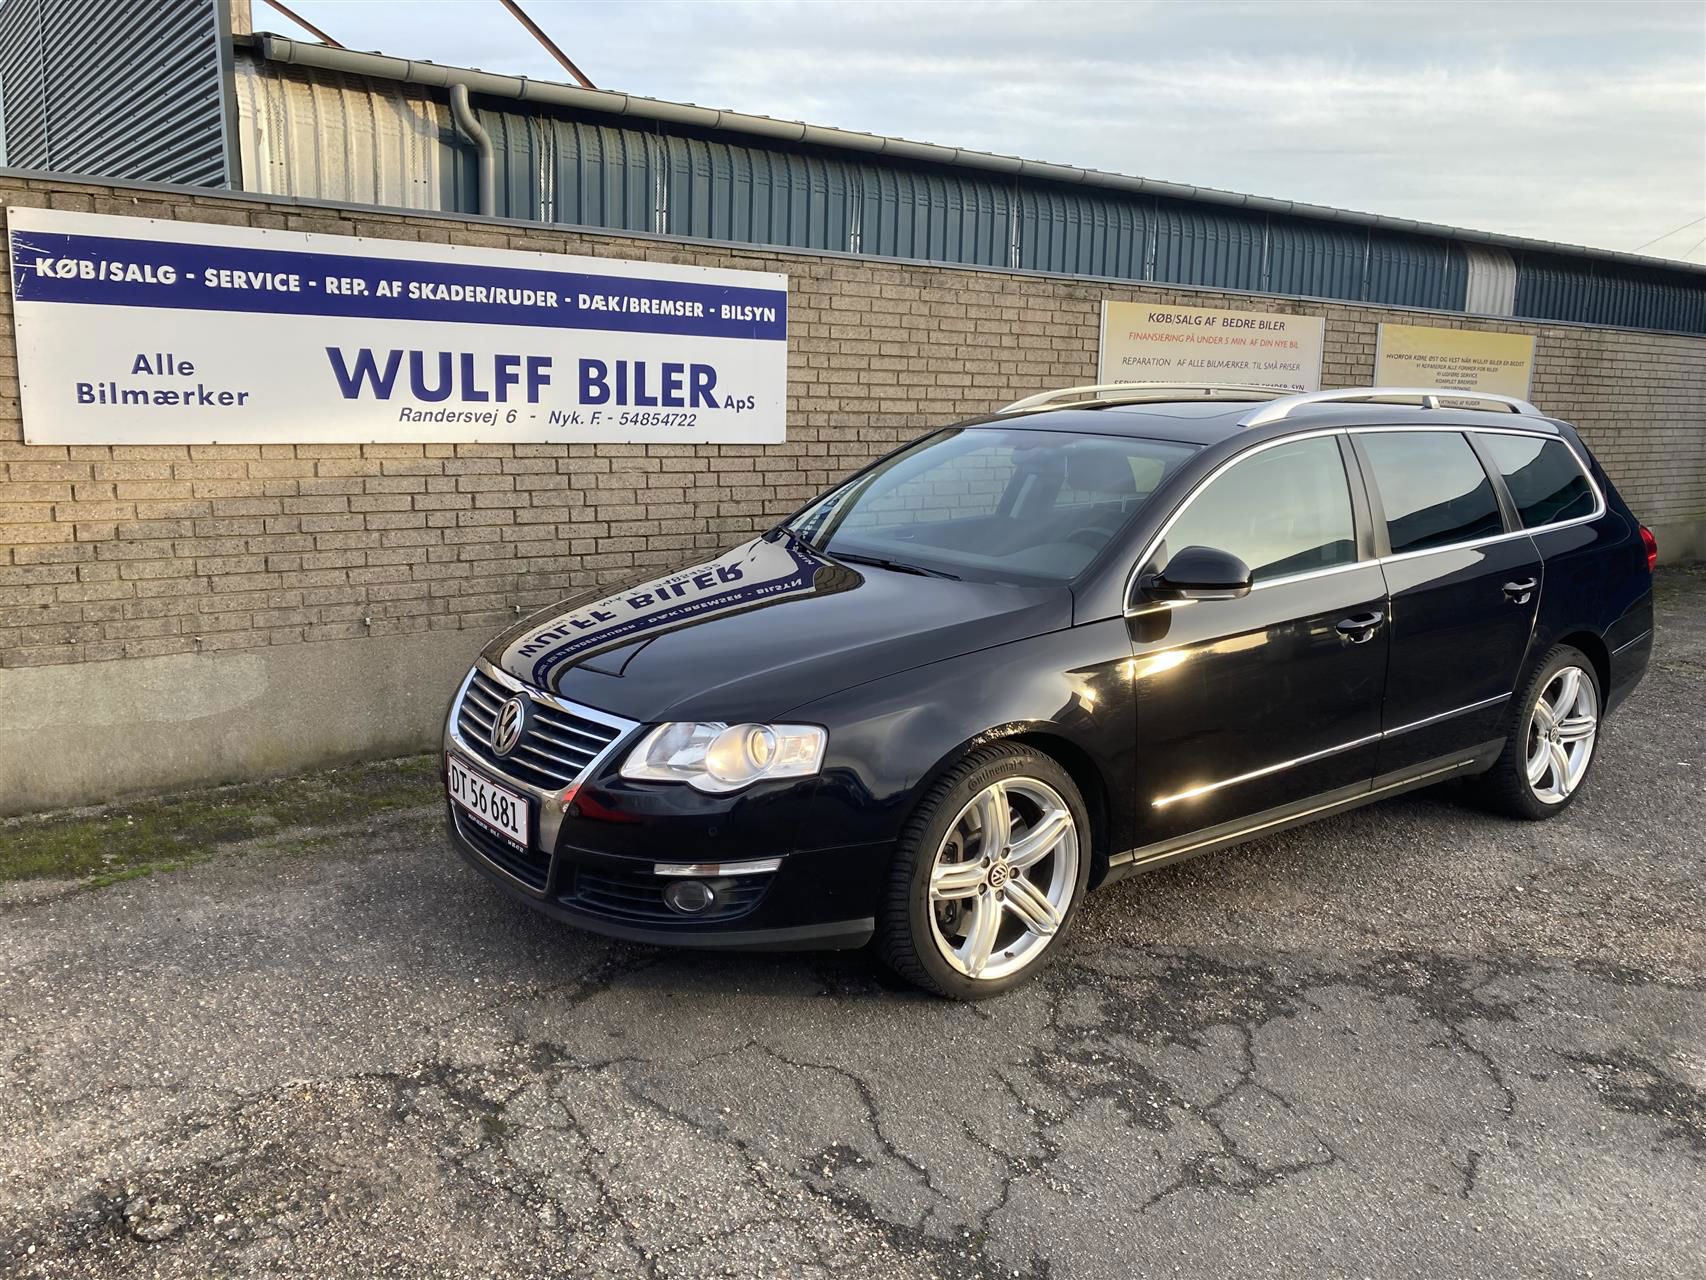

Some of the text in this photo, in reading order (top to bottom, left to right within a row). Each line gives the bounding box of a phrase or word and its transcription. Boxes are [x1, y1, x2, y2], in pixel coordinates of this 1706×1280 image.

[35, 256, 177, 286] KØB/SALG
[204, 267, 301, 292] SERVICE
[325, 276, 369, 296] REP.
[375, 280, 402, 299] AF
[408, 281, 559, 308] SKADER/RUDER
[578, 293, 704, 318] DÆK/BREMSER
[721, 304, 776, 323] BILSYN
[1148, 313, 1286, 331] KØB/SALG AF BEDRE BILER
[1128, 331, 1185, 343] FINANSIERING
[1196, 335, 1224, 345] UNDER
[1249, 338, 1260, 346] AF
[1260, 339, 1273, 348] DIN
[1274, 340, 1288, 349] NYE
[131, 353, 196, 377] Alle
[1122, 356, 1171, 367] REPARATION
[1176, 358, 1187, 367] AF
[1188, 359, 1205, 368] ALLE
[1206, 360, 1249, 369] BILMÆRKER
[1253, 361, 1262, 370] TIL
[1279, 362, 1301, 371] PRISER
[325, 346, 755, 414] WULFF BILER ApS
[76, 381, 249, 407] Bilmærker
[399, 407, 498, 426] Randersvej
[505, 409, 517, 424] 6
[548, 410, 585, 427] Nyk.
[619, 411, 697, 428] 54854722
[451, 764, 468, 801] DT
[471, 778, 488, 815] 56
[491, 794, 519, 834] 681
